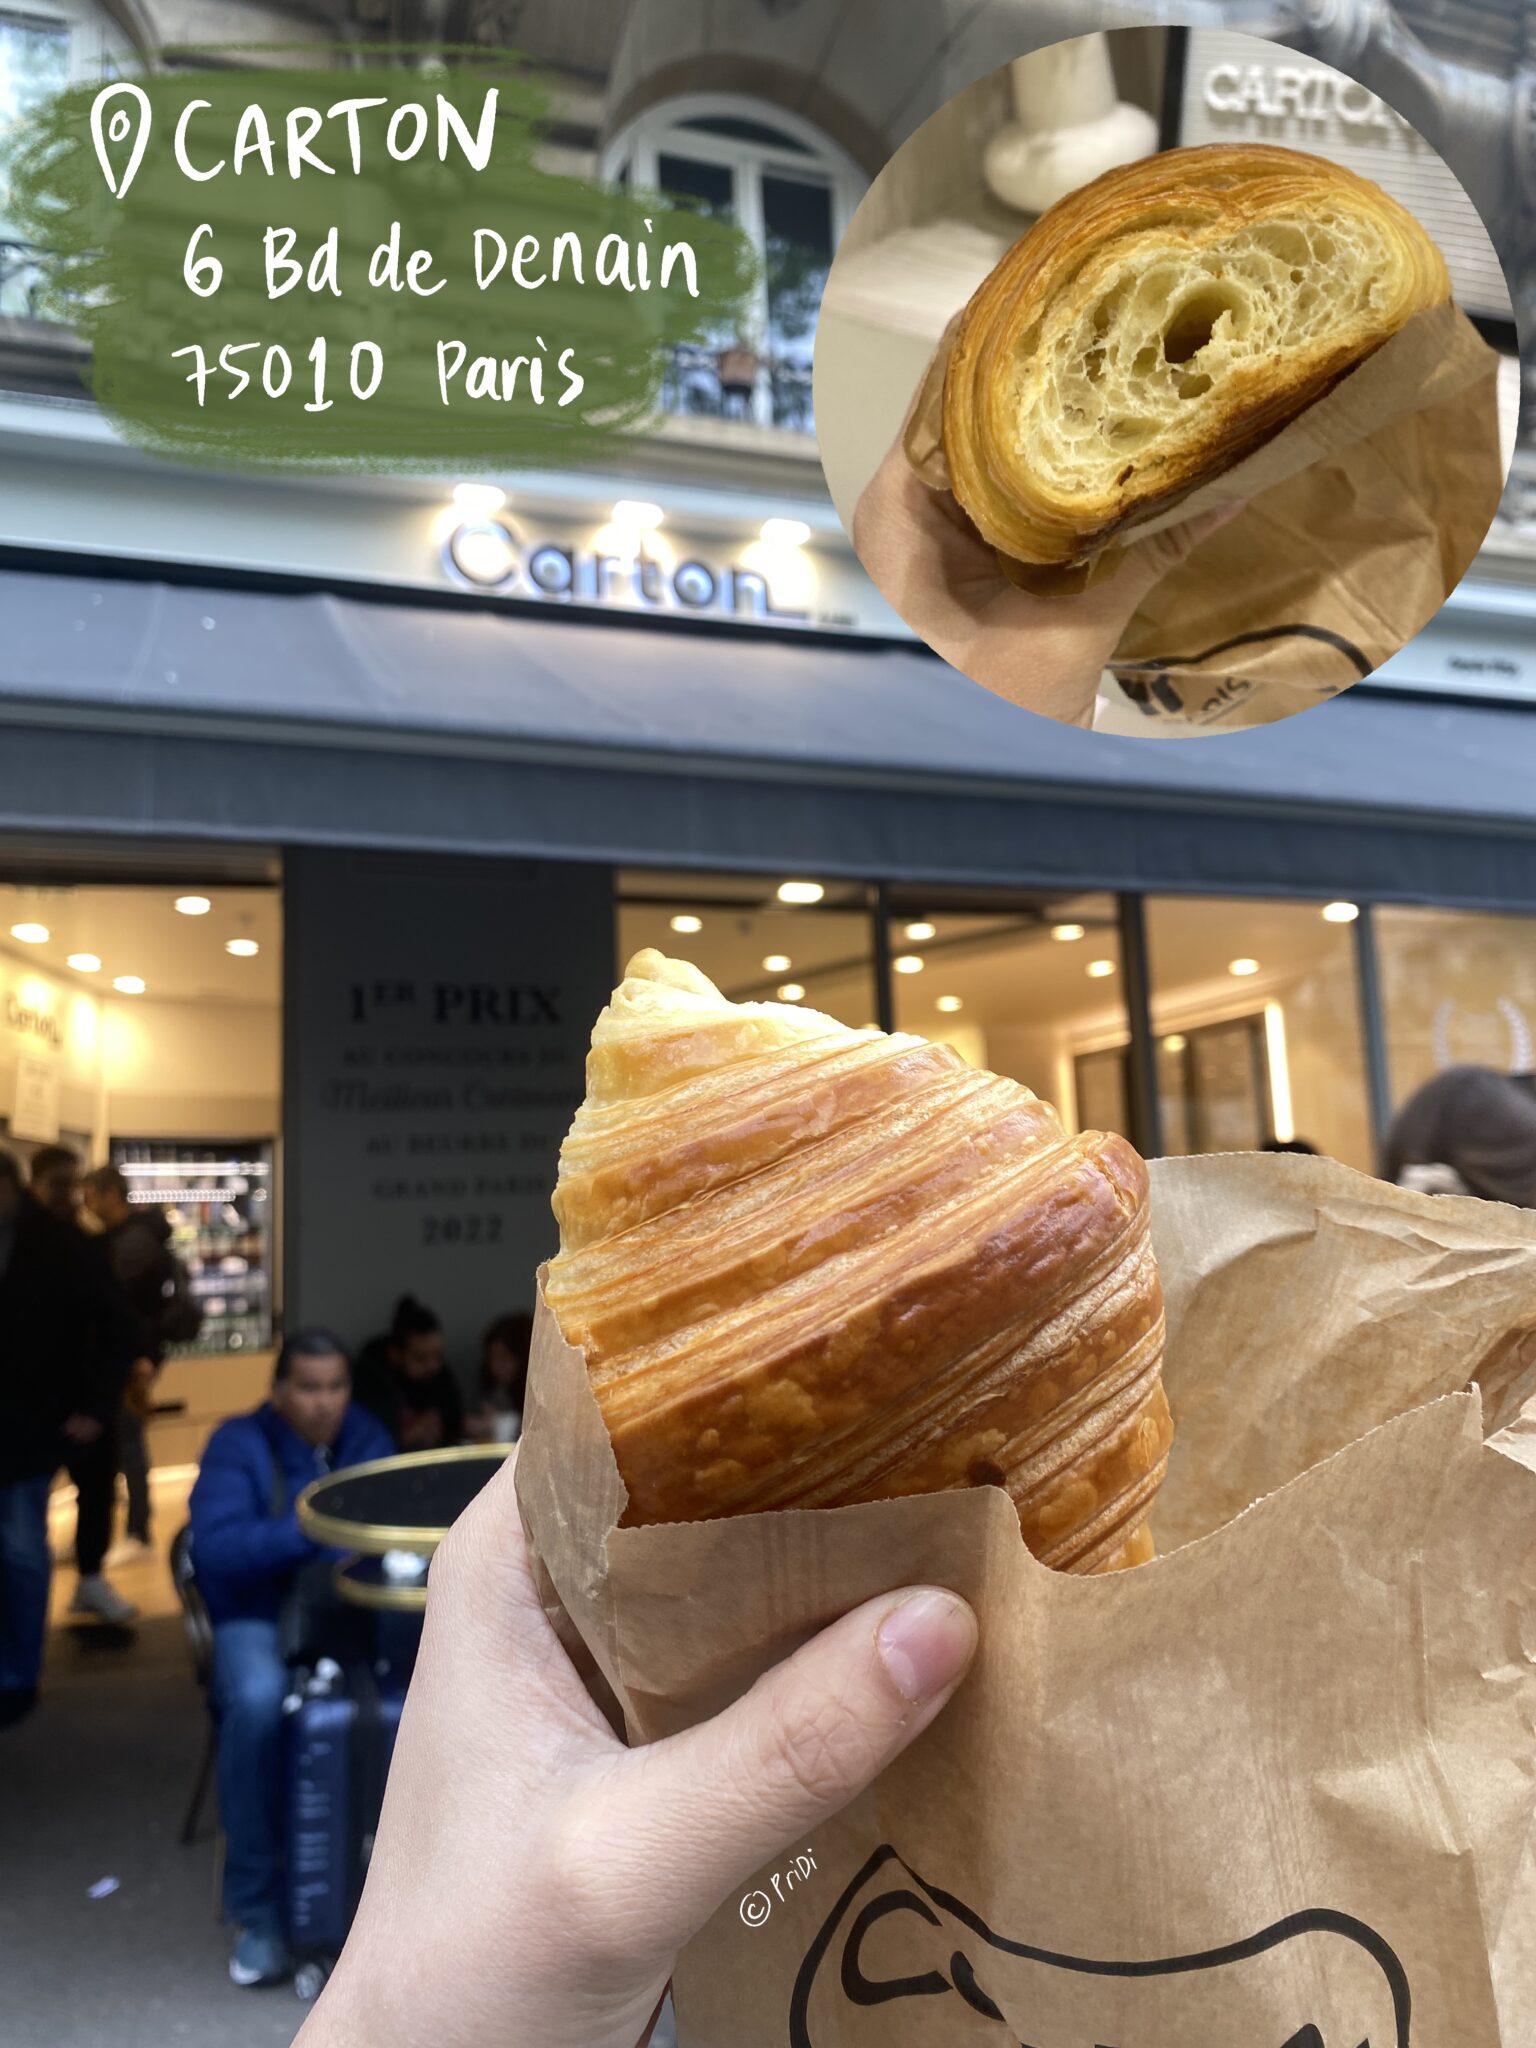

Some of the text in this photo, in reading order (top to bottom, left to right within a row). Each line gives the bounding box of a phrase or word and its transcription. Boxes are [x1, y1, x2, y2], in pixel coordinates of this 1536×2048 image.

[443, 519, 772, 619] Carton
[434, 983, 564, 1024] PRIX
[420, 1214, 503, 1248] 2022
